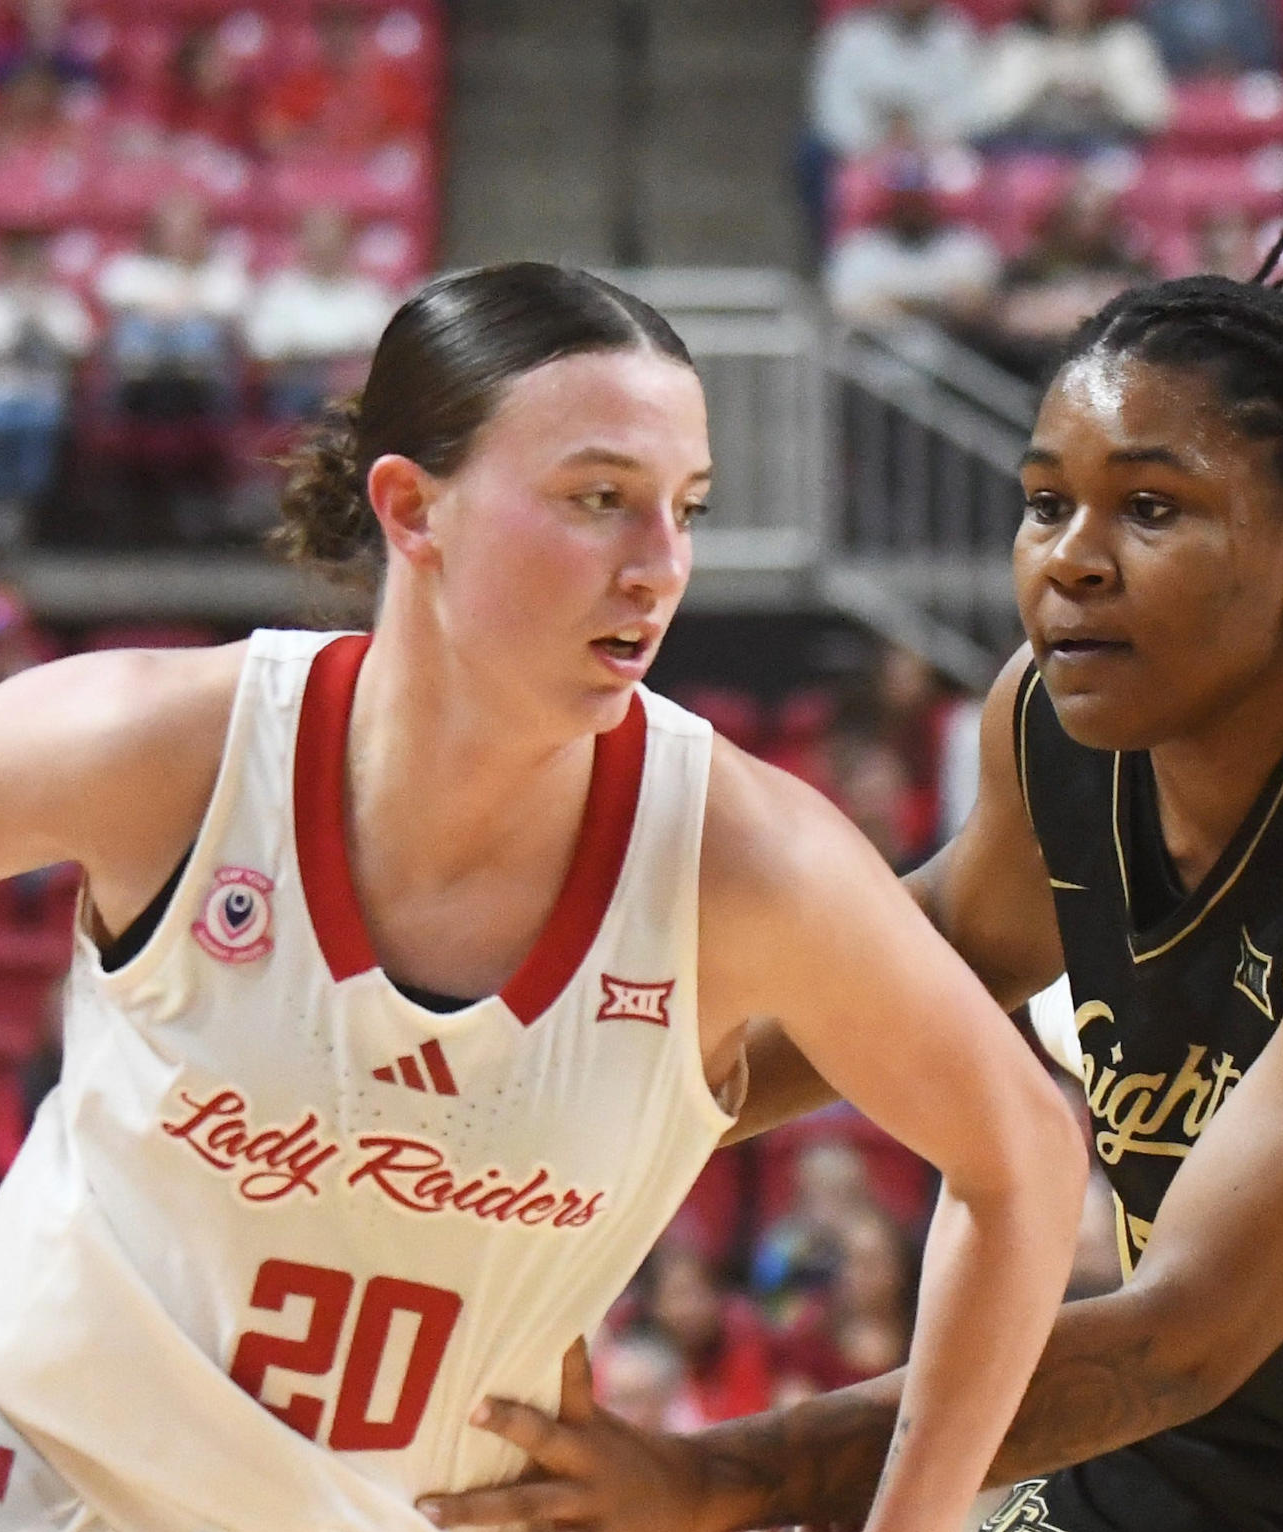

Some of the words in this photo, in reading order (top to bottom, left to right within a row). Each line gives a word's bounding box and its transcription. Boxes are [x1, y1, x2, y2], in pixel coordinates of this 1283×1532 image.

[162, 1090, 339, 1202] Lady
[348, 1137, 604, 1227] Raiders
[229, 1257, 464, 1452] 20
